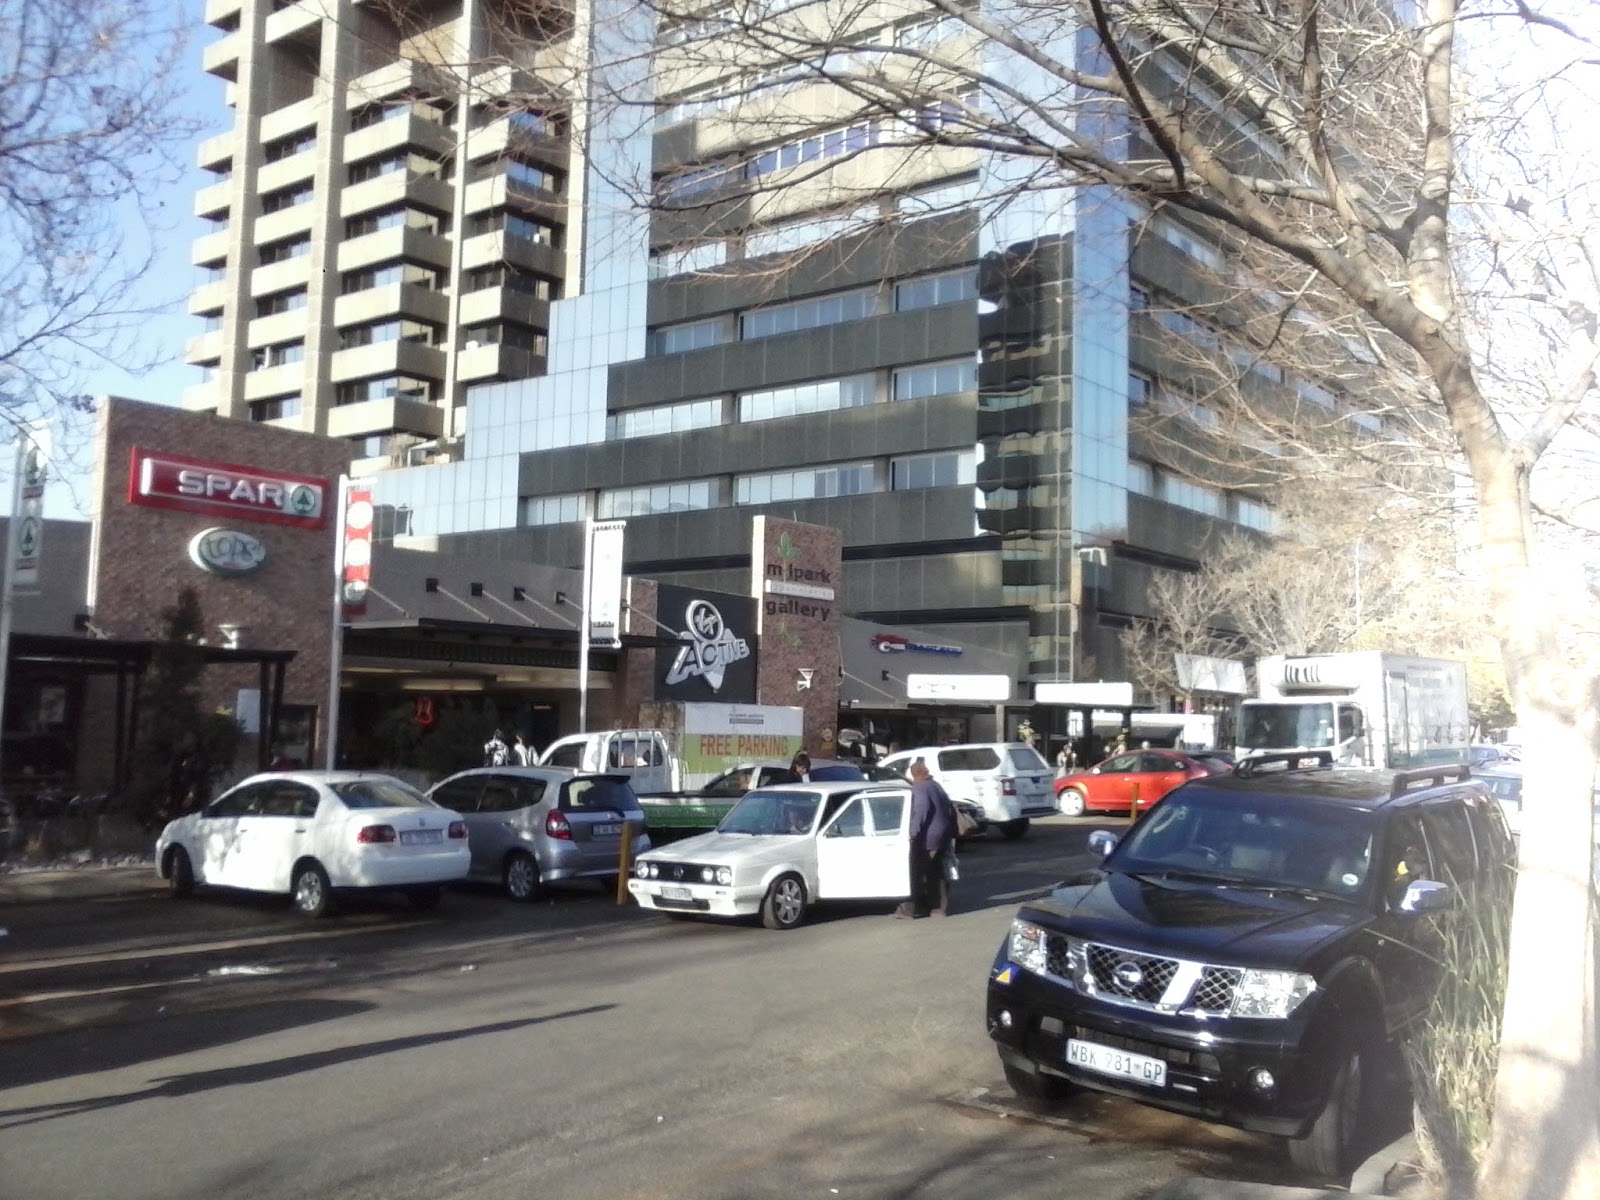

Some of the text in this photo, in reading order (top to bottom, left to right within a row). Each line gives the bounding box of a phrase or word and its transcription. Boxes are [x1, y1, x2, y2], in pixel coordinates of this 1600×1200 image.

[178, 470, 285, 507] SPAR
[766, 600, 830, 621] gallery
[667, 636, 750, 677] ACTIVE
[700, 734, 788, 756] FREE PARKING
[1071, 1043, 1096, 1065] WBK
[1143, 1061, 1162, 1081] GP
